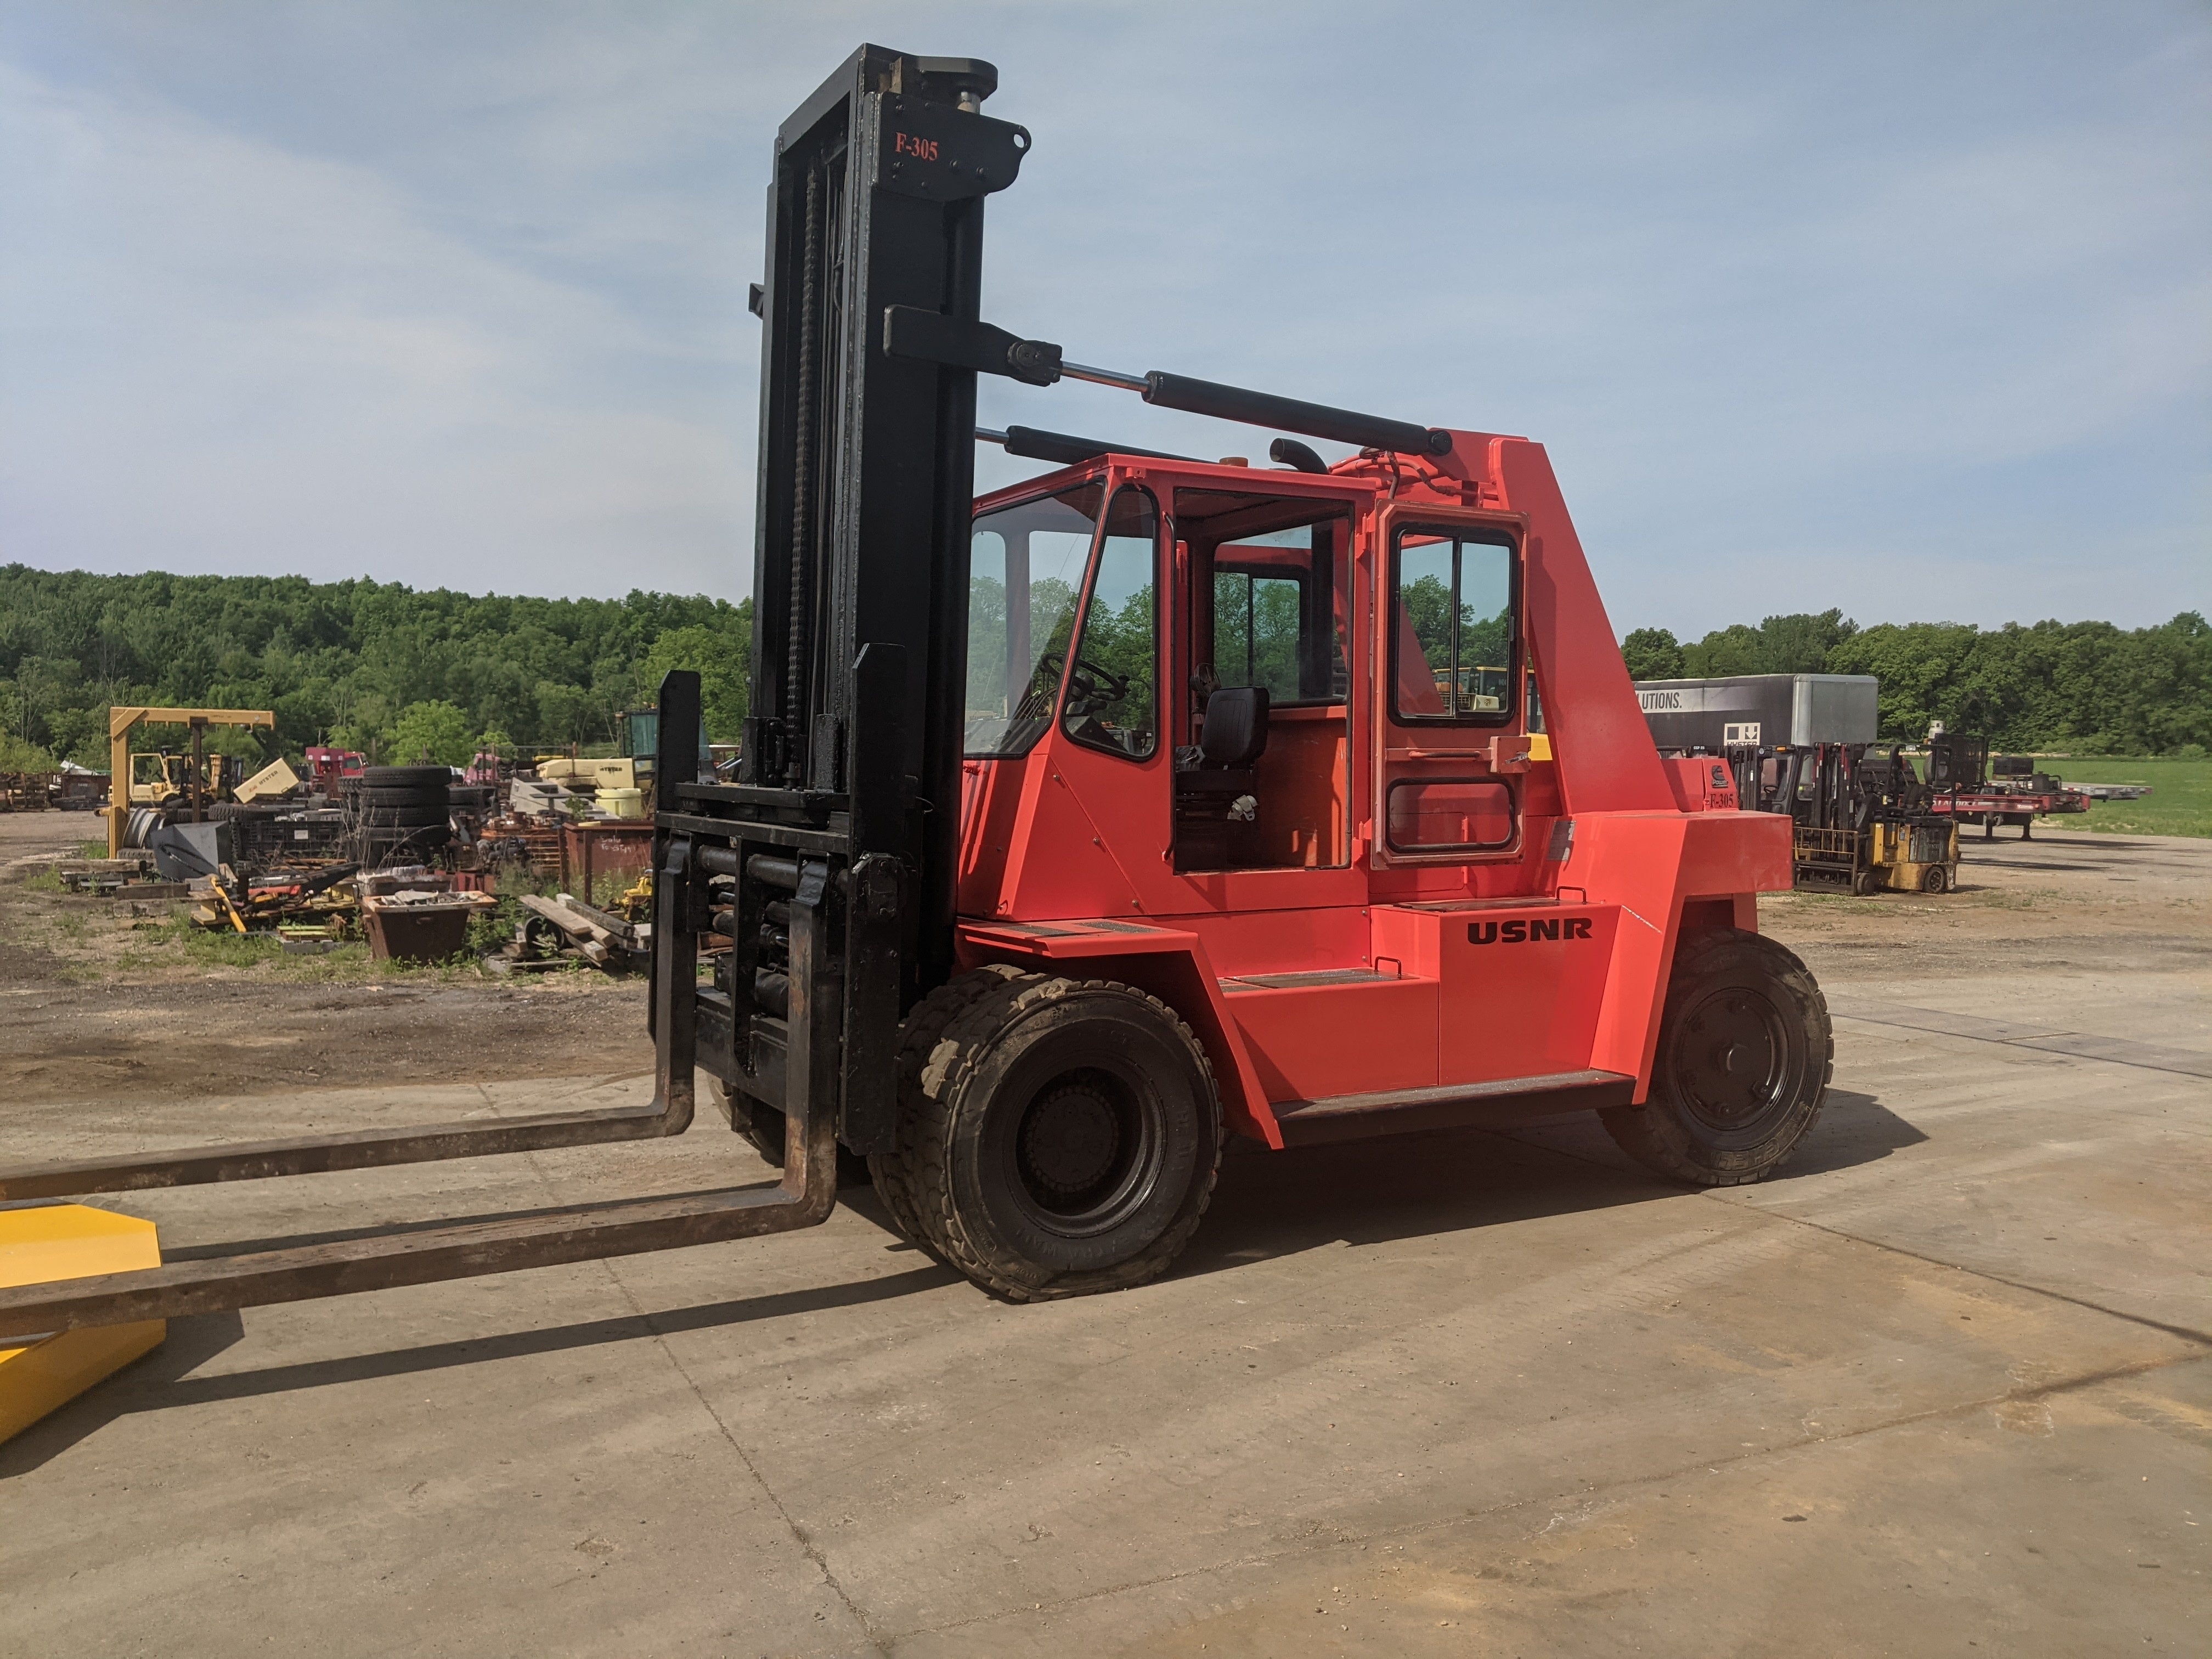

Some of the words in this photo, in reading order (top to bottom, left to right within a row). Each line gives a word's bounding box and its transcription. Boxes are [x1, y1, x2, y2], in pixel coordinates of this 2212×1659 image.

[895, 132, 939, 161] F-305
[1710, 793, 1734, 808] F-305
[1468, 917, 1593, 945] USNR
